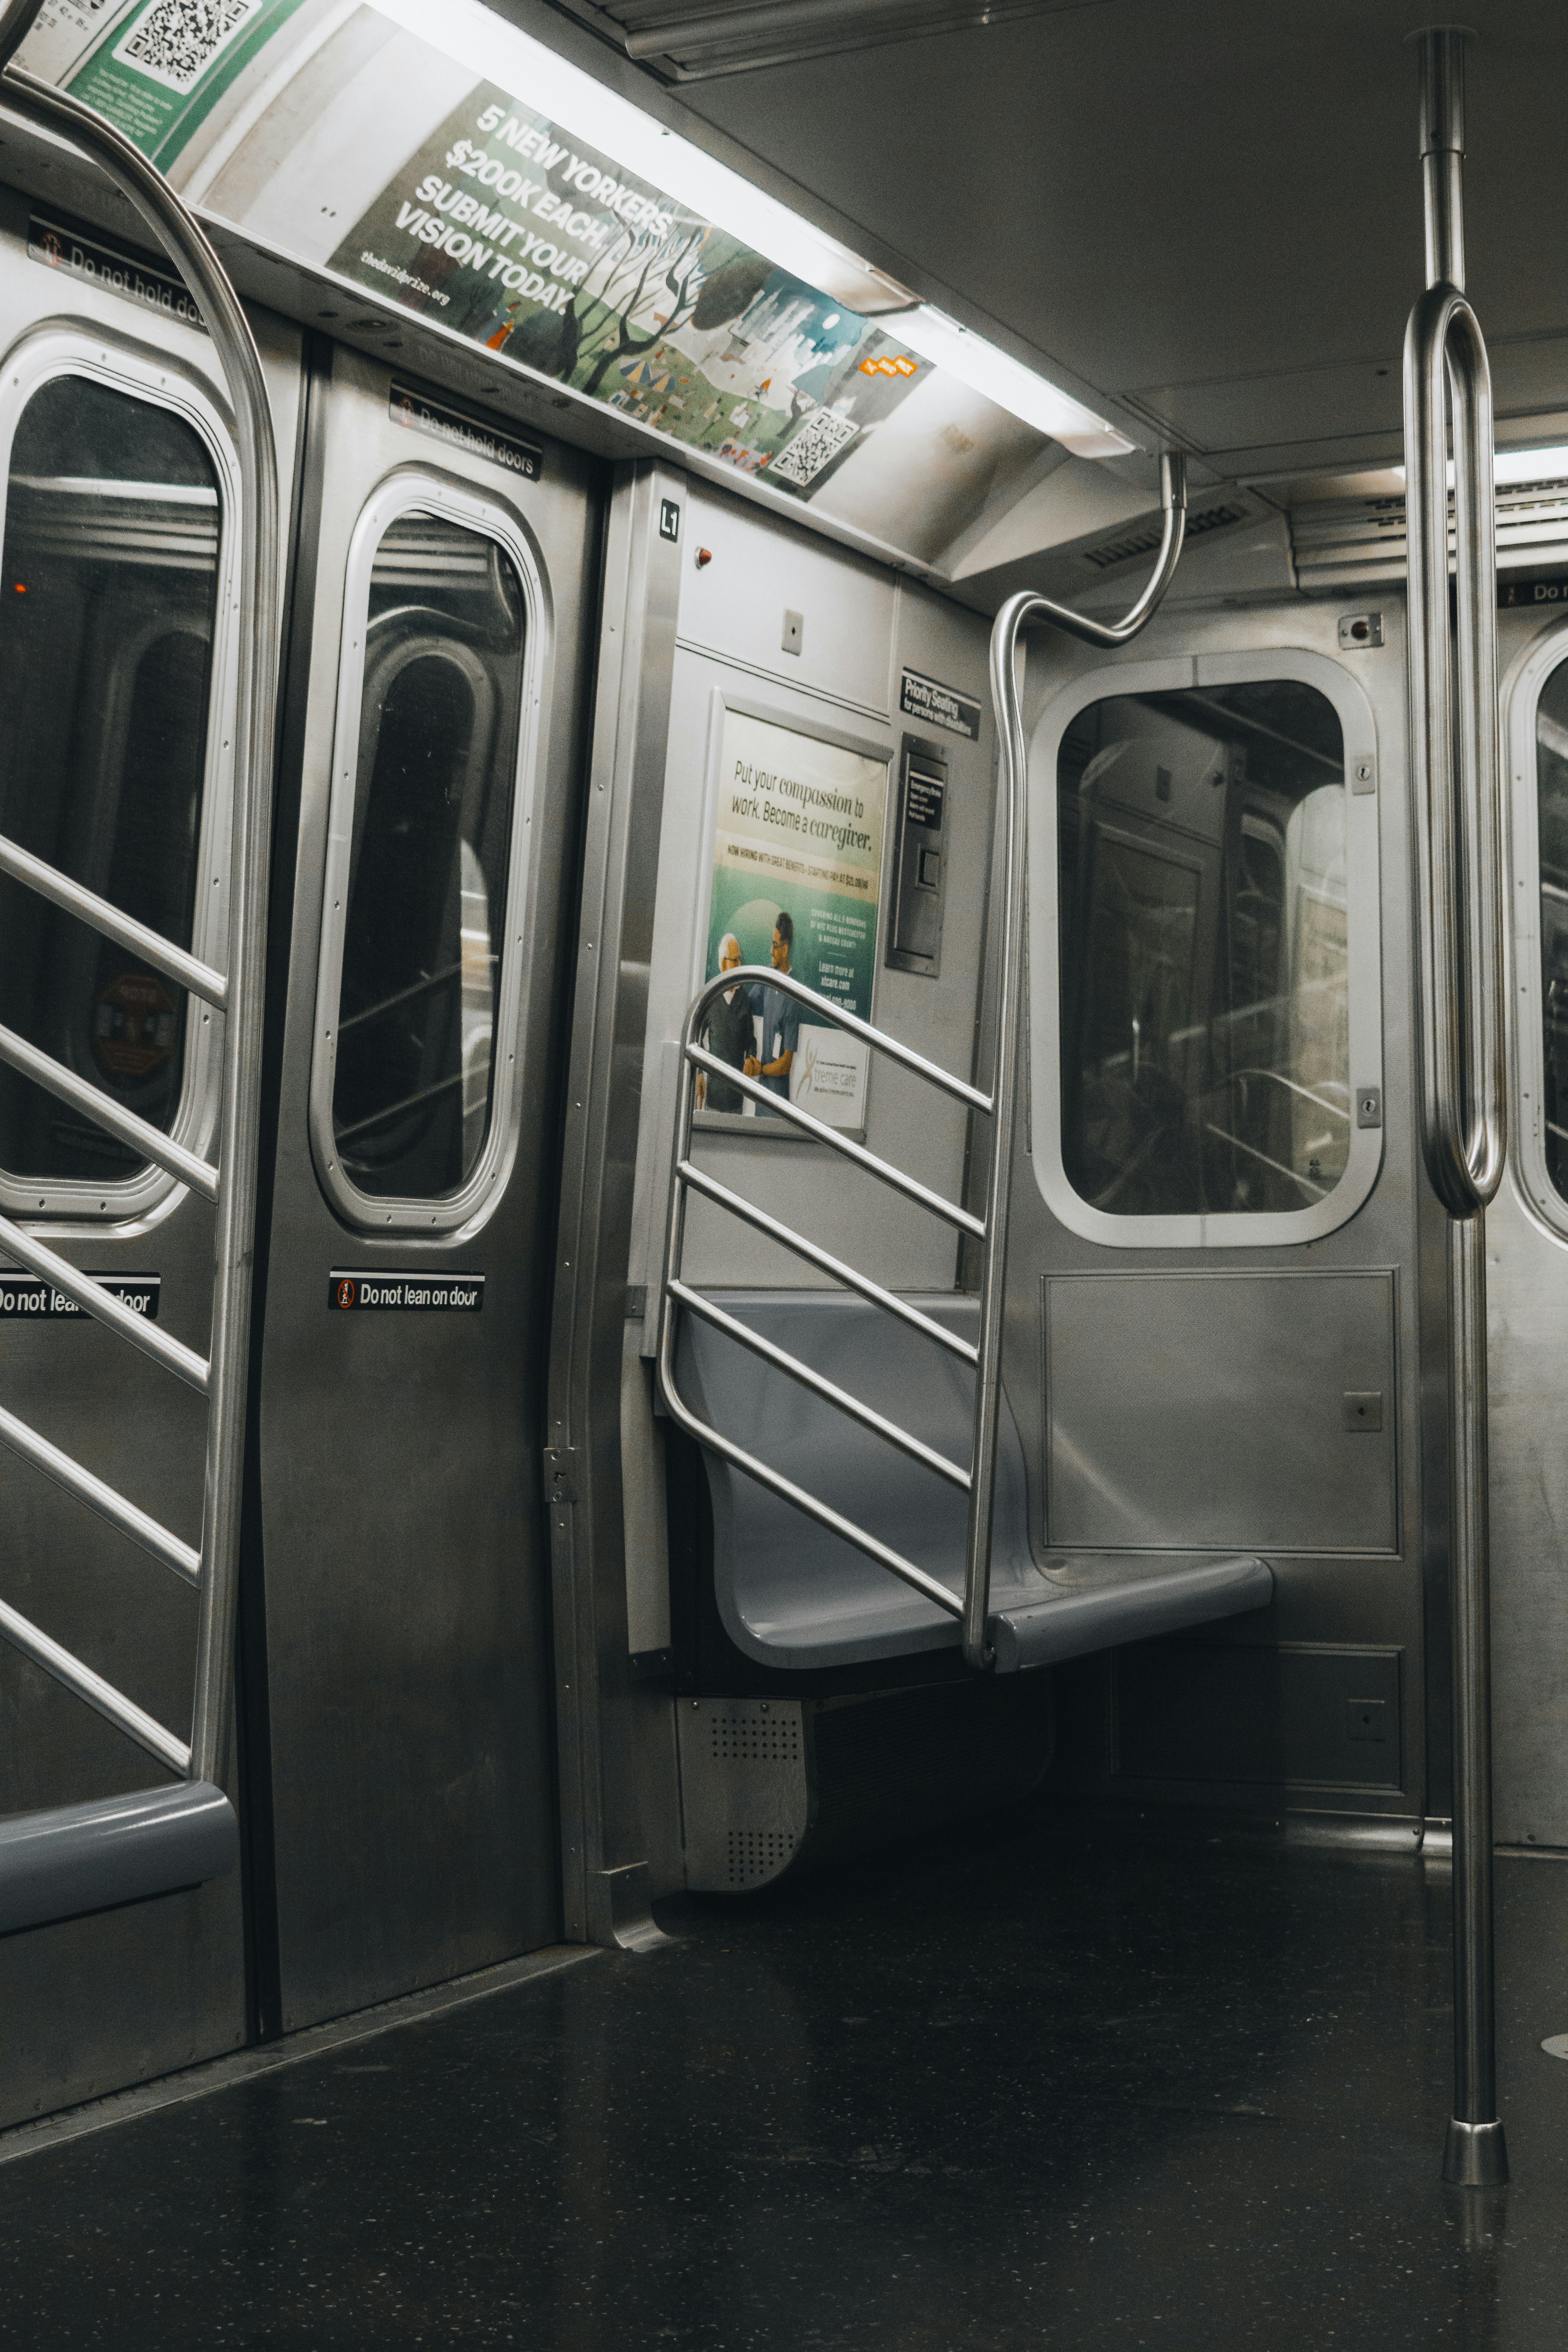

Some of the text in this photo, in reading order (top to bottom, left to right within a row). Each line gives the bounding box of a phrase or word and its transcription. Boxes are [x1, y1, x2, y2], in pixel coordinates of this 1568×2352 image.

[446, 140, 610, 250] $200K EACH.
[477, 104, 673, 240] 5 NEW YORKERS.
[395, 201, 575, 315] VISION TODAY.
[416, 176, 589, 285] SUBMIT YOUR
[71, 246, 95, 276] Do
[102, 264, 130, 291] not
[135, 275, 172, 310] hold
[361, 251, 450, 306] thedavidprize.org
[421, 408, 438, 432] Do
[467, 429, 495, 459] hold
[498, 444, 533, 474] doors
[661, 506, 677, 535] L1
[1535, 585, 1559, 600] Do
[905, 679, 958, 719] Priority Seating
[735, 760, 863, 818] Put your compassion to
[732, 796, 871, 851] work. Become a caregiver.
[819, 961, 854, 978] Learn more at
[840, 1073, 857, 1087] care
[17, 1290, 46, 1311] not
[360, 1284, 478, 1305] Do not lean on door
